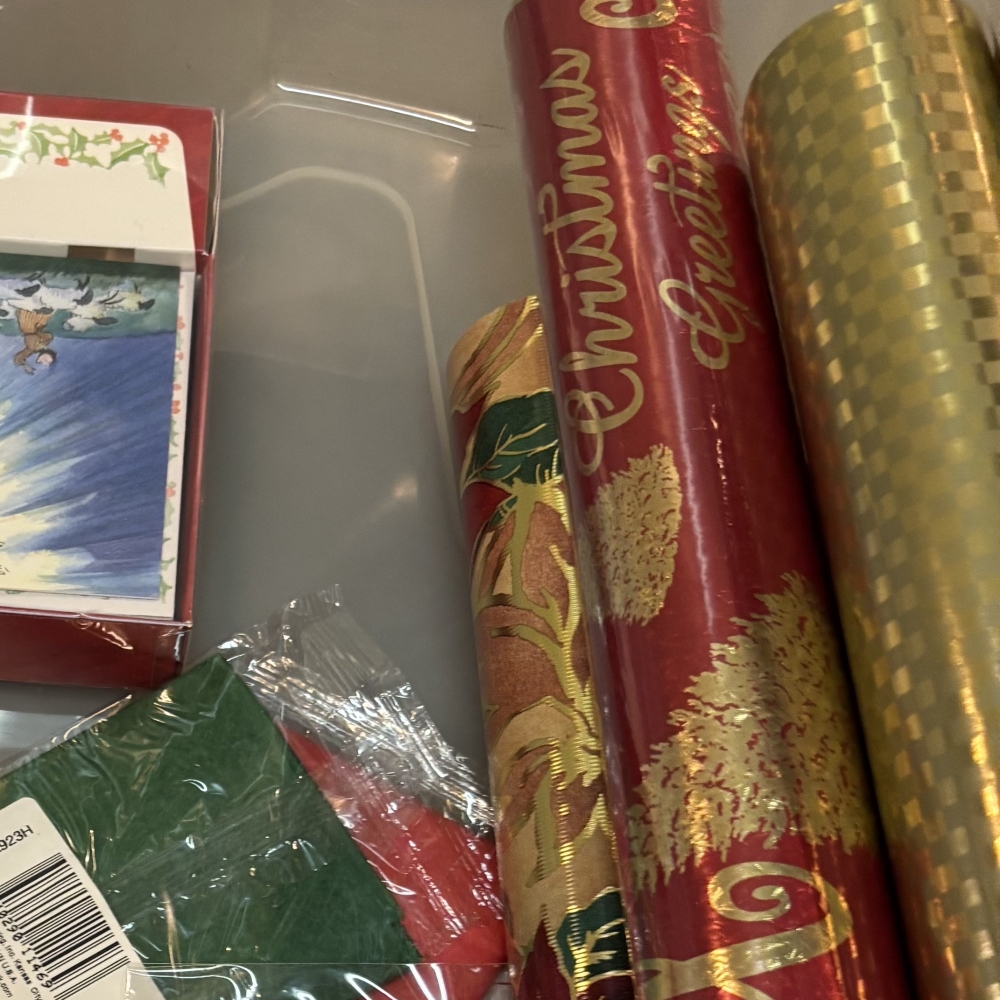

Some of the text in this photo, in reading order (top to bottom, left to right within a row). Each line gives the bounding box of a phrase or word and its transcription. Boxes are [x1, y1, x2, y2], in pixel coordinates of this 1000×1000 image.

[537, 48, 645, 476] Christmas
[646, 63, 752, 370] Greetings
[1, 961, 19, 985] U.S.A.
[21, 947, 54, 989] 11469
